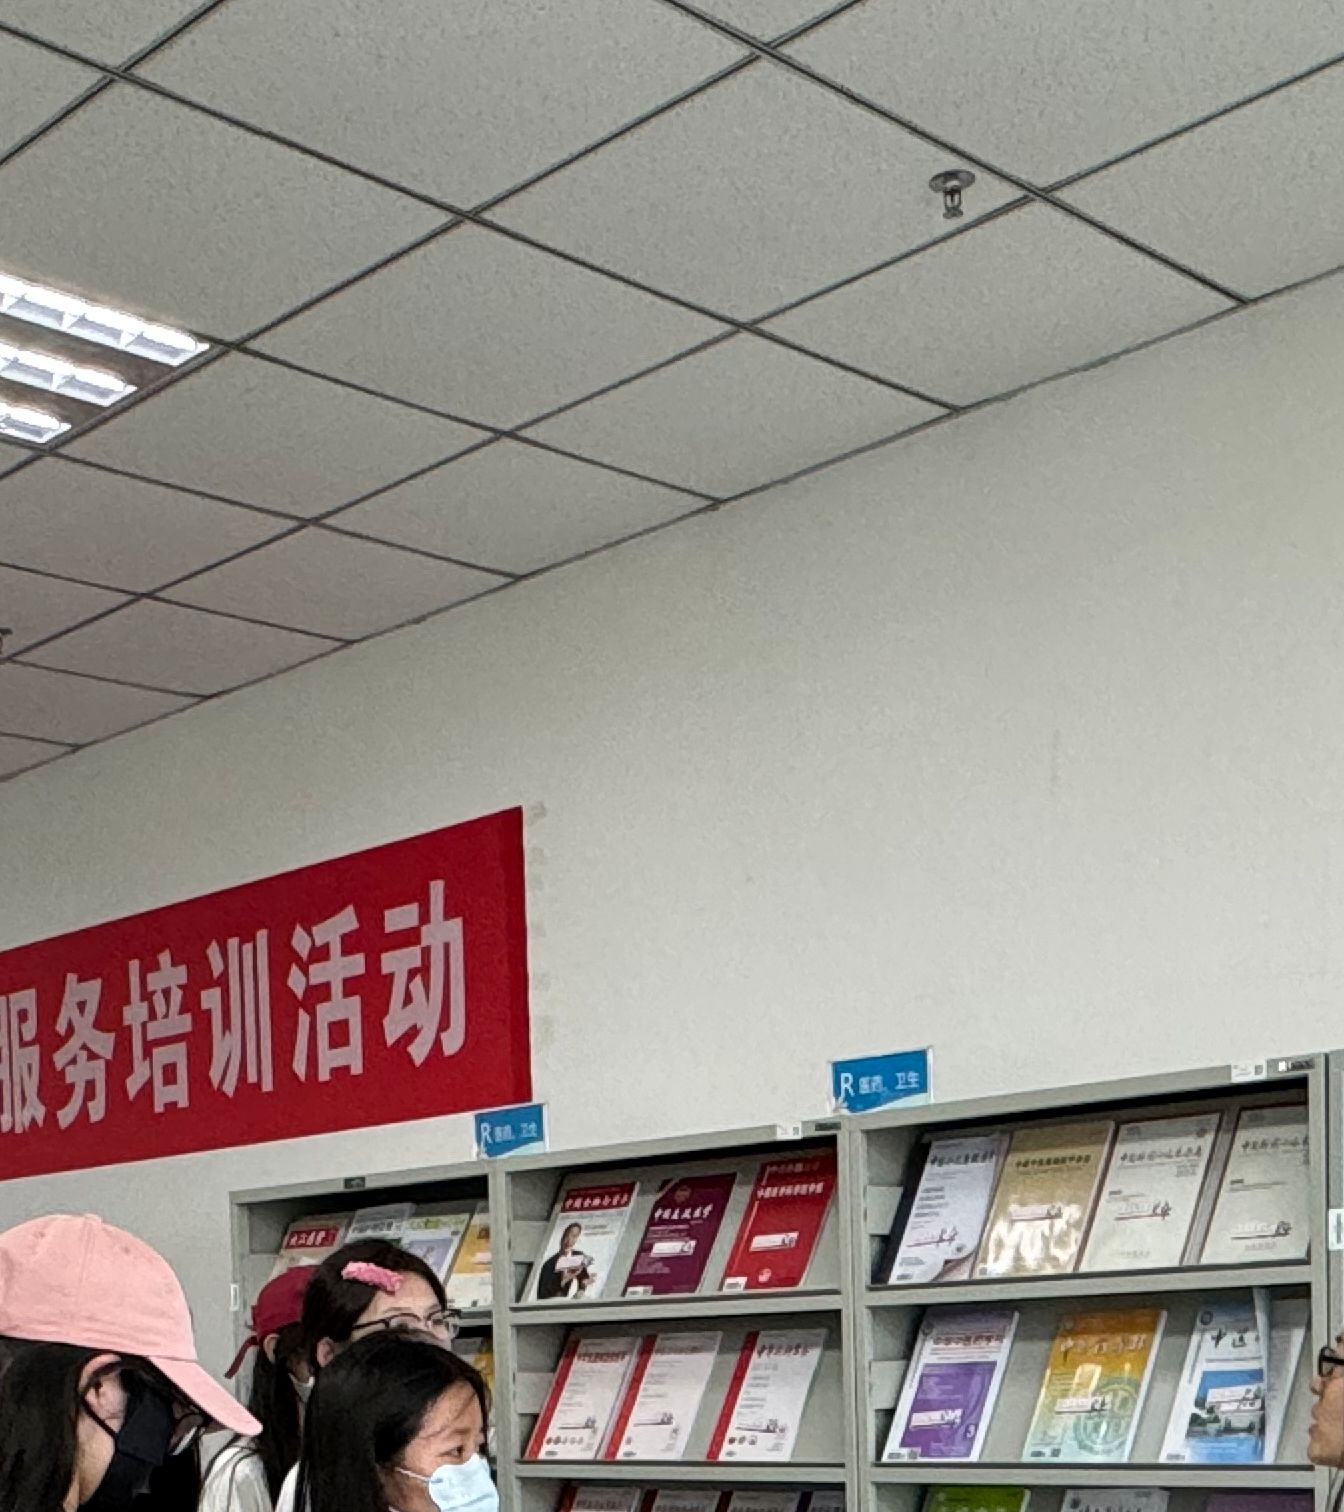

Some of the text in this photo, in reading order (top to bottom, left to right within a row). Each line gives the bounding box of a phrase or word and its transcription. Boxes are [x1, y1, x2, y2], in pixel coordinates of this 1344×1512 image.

[841, 1072, 855, 1100] R
[895, 1070, 920, 1090] 卫生
[480, 1121, 493, 1145] R
